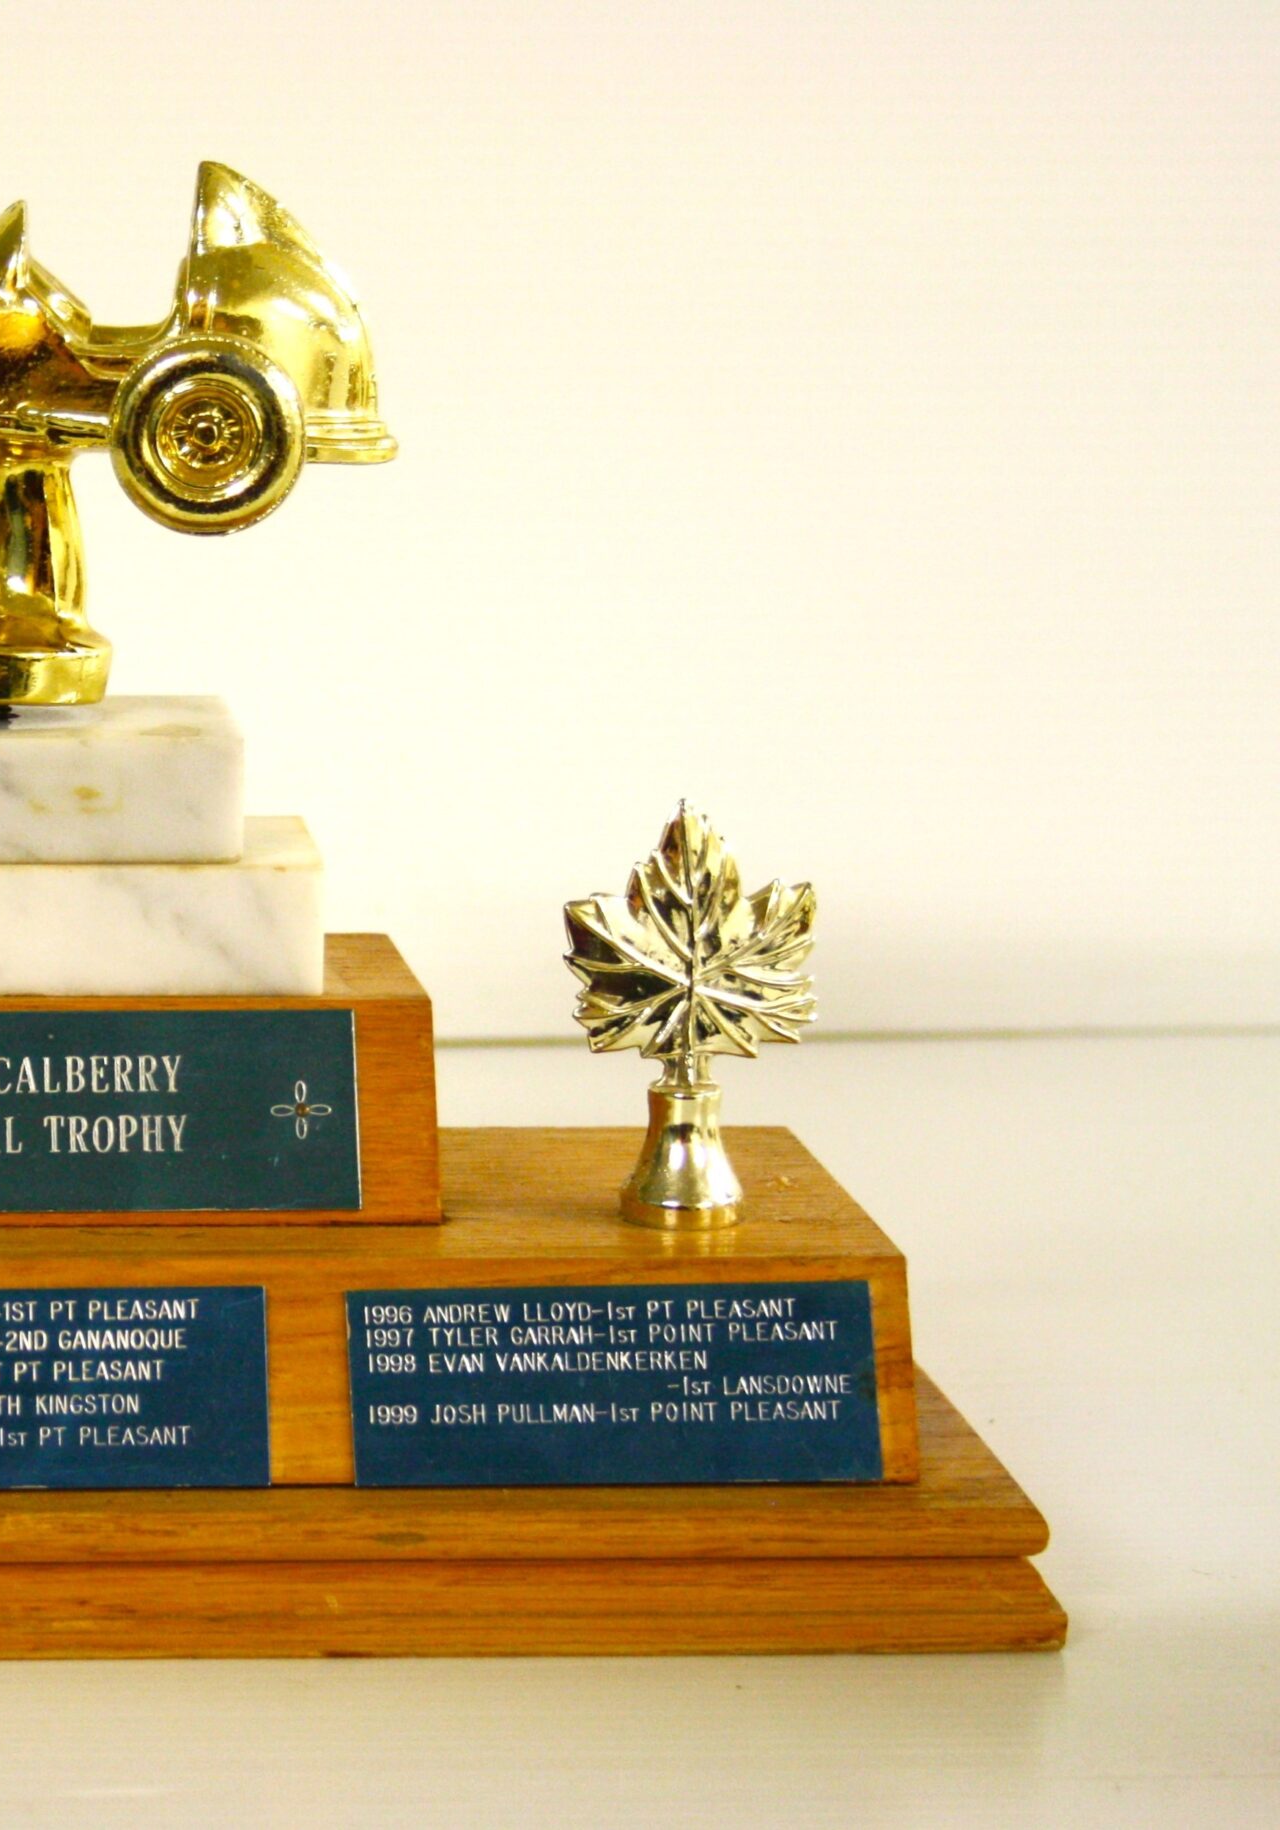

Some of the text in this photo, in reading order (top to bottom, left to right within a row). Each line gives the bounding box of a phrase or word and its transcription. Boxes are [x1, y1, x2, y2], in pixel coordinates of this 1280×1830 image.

[42, 1113, 188, 1154] TROPHY
[49, 1299, 78, 1322] PT
[87, 1297, 200, 1321] PLEASANT
[363, 1304, 413, 1326] 1996
[422, 1303, 511, 1325] ANDREW
[646, 1299, 675, 1320] PT
[685, 1297, 796, 1320] PLEASANT
[57, 1327, 188, 1351] GANANOQUE
[365, 1327, 415, 1349] 1997
[427, 1326, 499, 1348] TYLER
[648, 1322, 715, 1344] POINT
[727, 1319, 839, 1343] PLEASANT
[13, 1360, 42, 1384] PT
[52, 1358, 165, 1383] PLEASANT
[368, 1352, 418, 1374] 1998
[428, 1352, 486, 1375] EVAN
[722, 1373, 852, 1397] LANSDOWNE
[35, 1393, 141, 1416] KINGSTON
[368, 1403, 419, 1426] 1999
[430, 1402, 487, 1426] JOSH
[650, 1401, 718, 1423] POINT
[730, 1399, 841, 1423] PLEASANT
[38, 1426, 67, 1447] PT
[79, 1424, 192, 1447] PLEASANT
